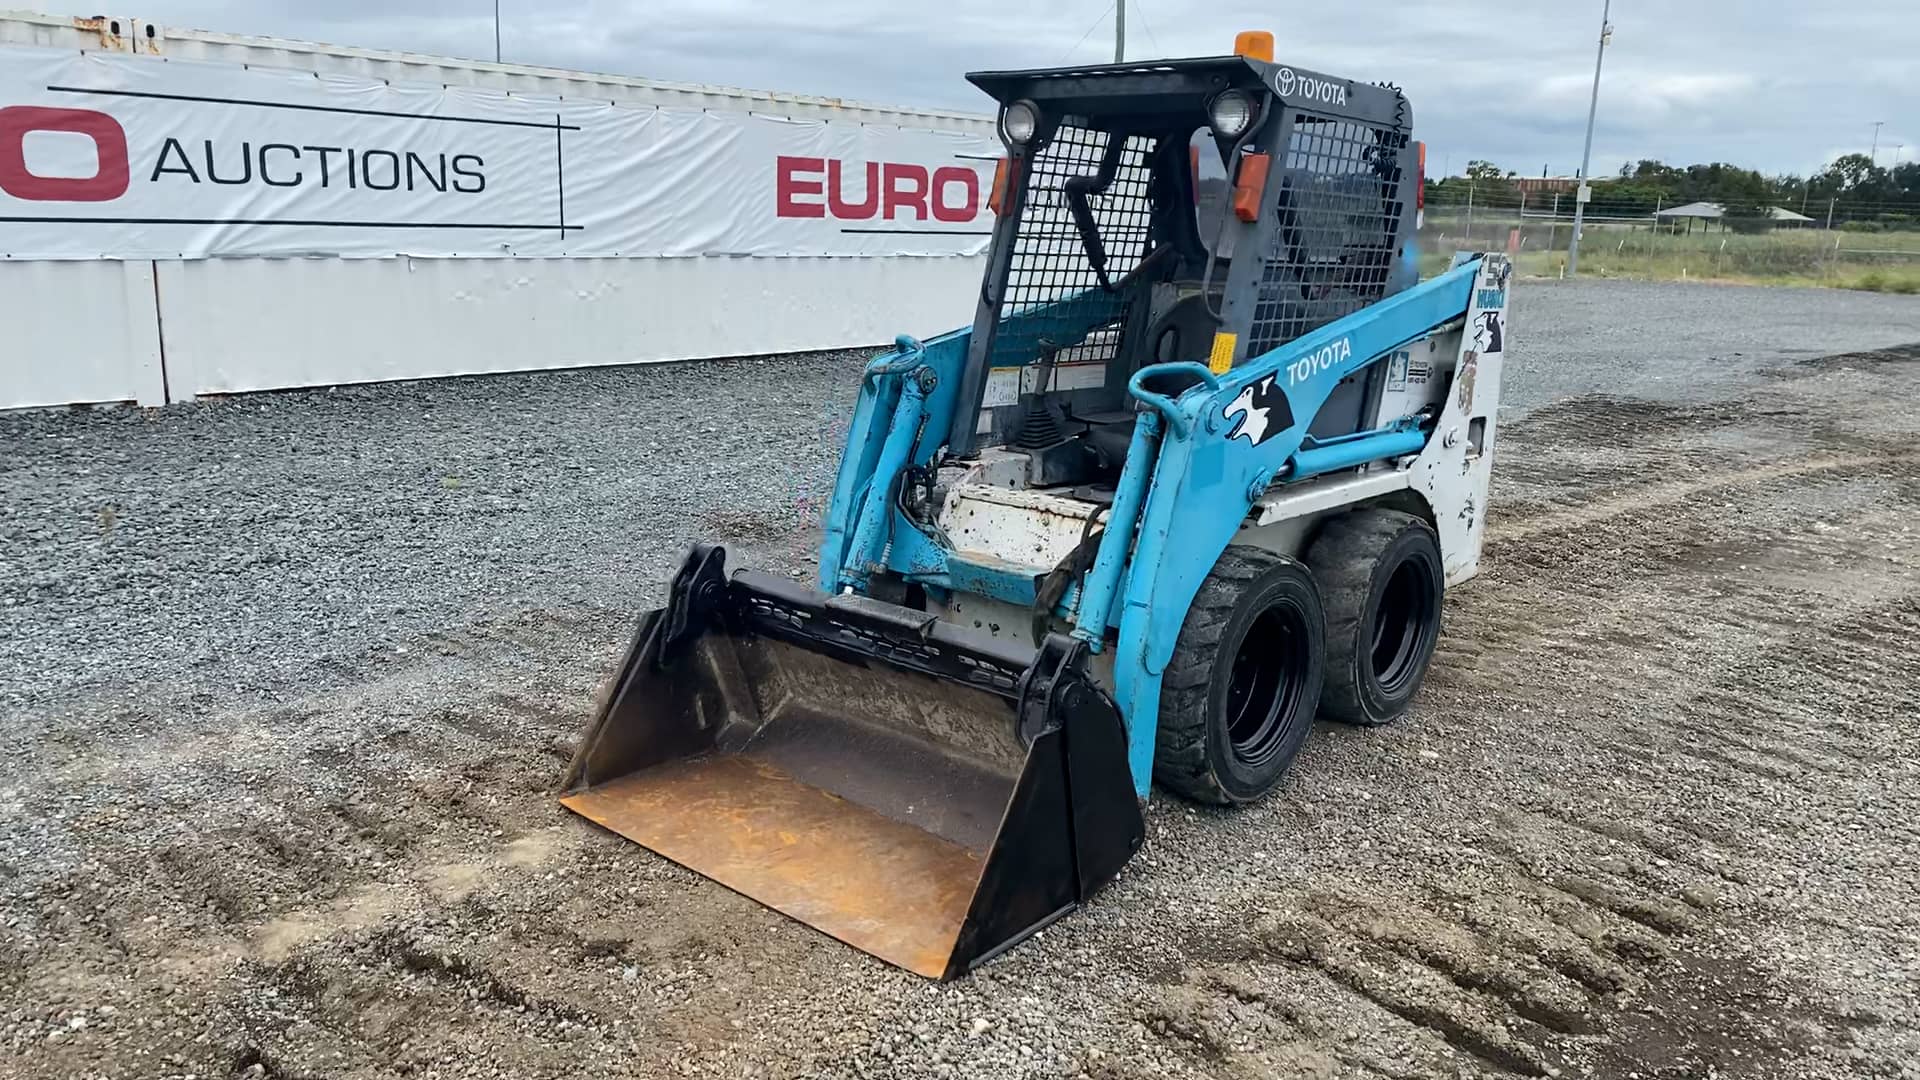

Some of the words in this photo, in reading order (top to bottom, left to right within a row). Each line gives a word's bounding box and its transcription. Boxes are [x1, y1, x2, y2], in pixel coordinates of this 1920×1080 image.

[1297, 75, 1346, 106] TOYOTA
[150, 137, 486, 194] AUCTIONS
[776, 155, 979, 223] EURO
[1287, 338, 1352, 386] TOYOTA
